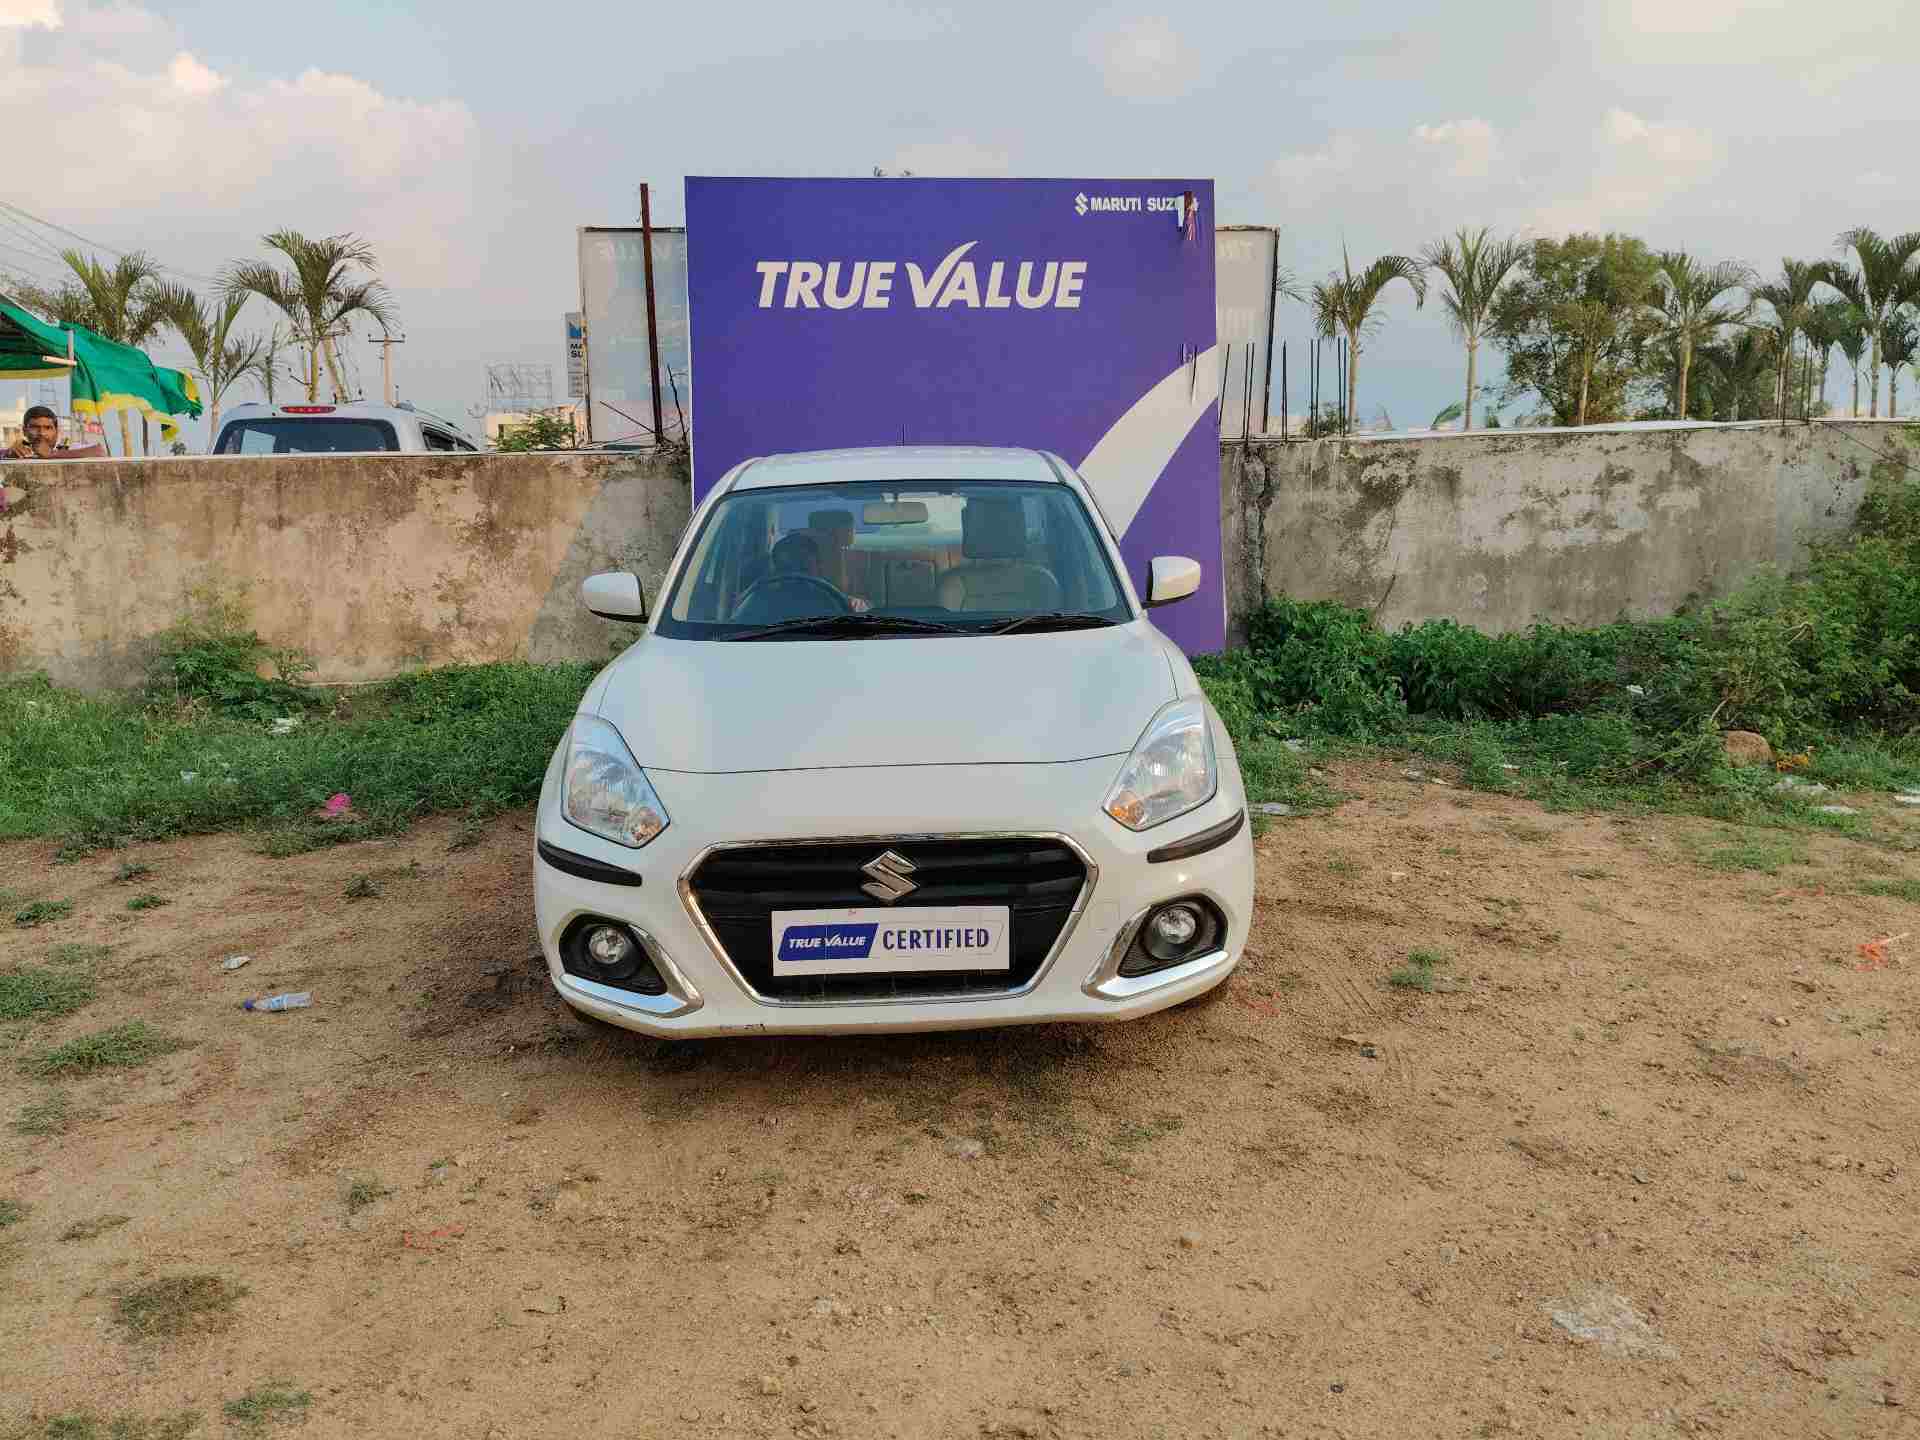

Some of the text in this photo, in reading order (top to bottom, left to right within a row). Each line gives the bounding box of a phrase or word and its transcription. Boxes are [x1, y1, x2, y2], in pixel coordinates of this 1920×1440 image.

[1091, 197, 1142, 211] MARUTI
[756, 240, 1088, 309] TRUE VALUE
[788, 928, 990, 951] TRUE VALUE CERTIFIED
